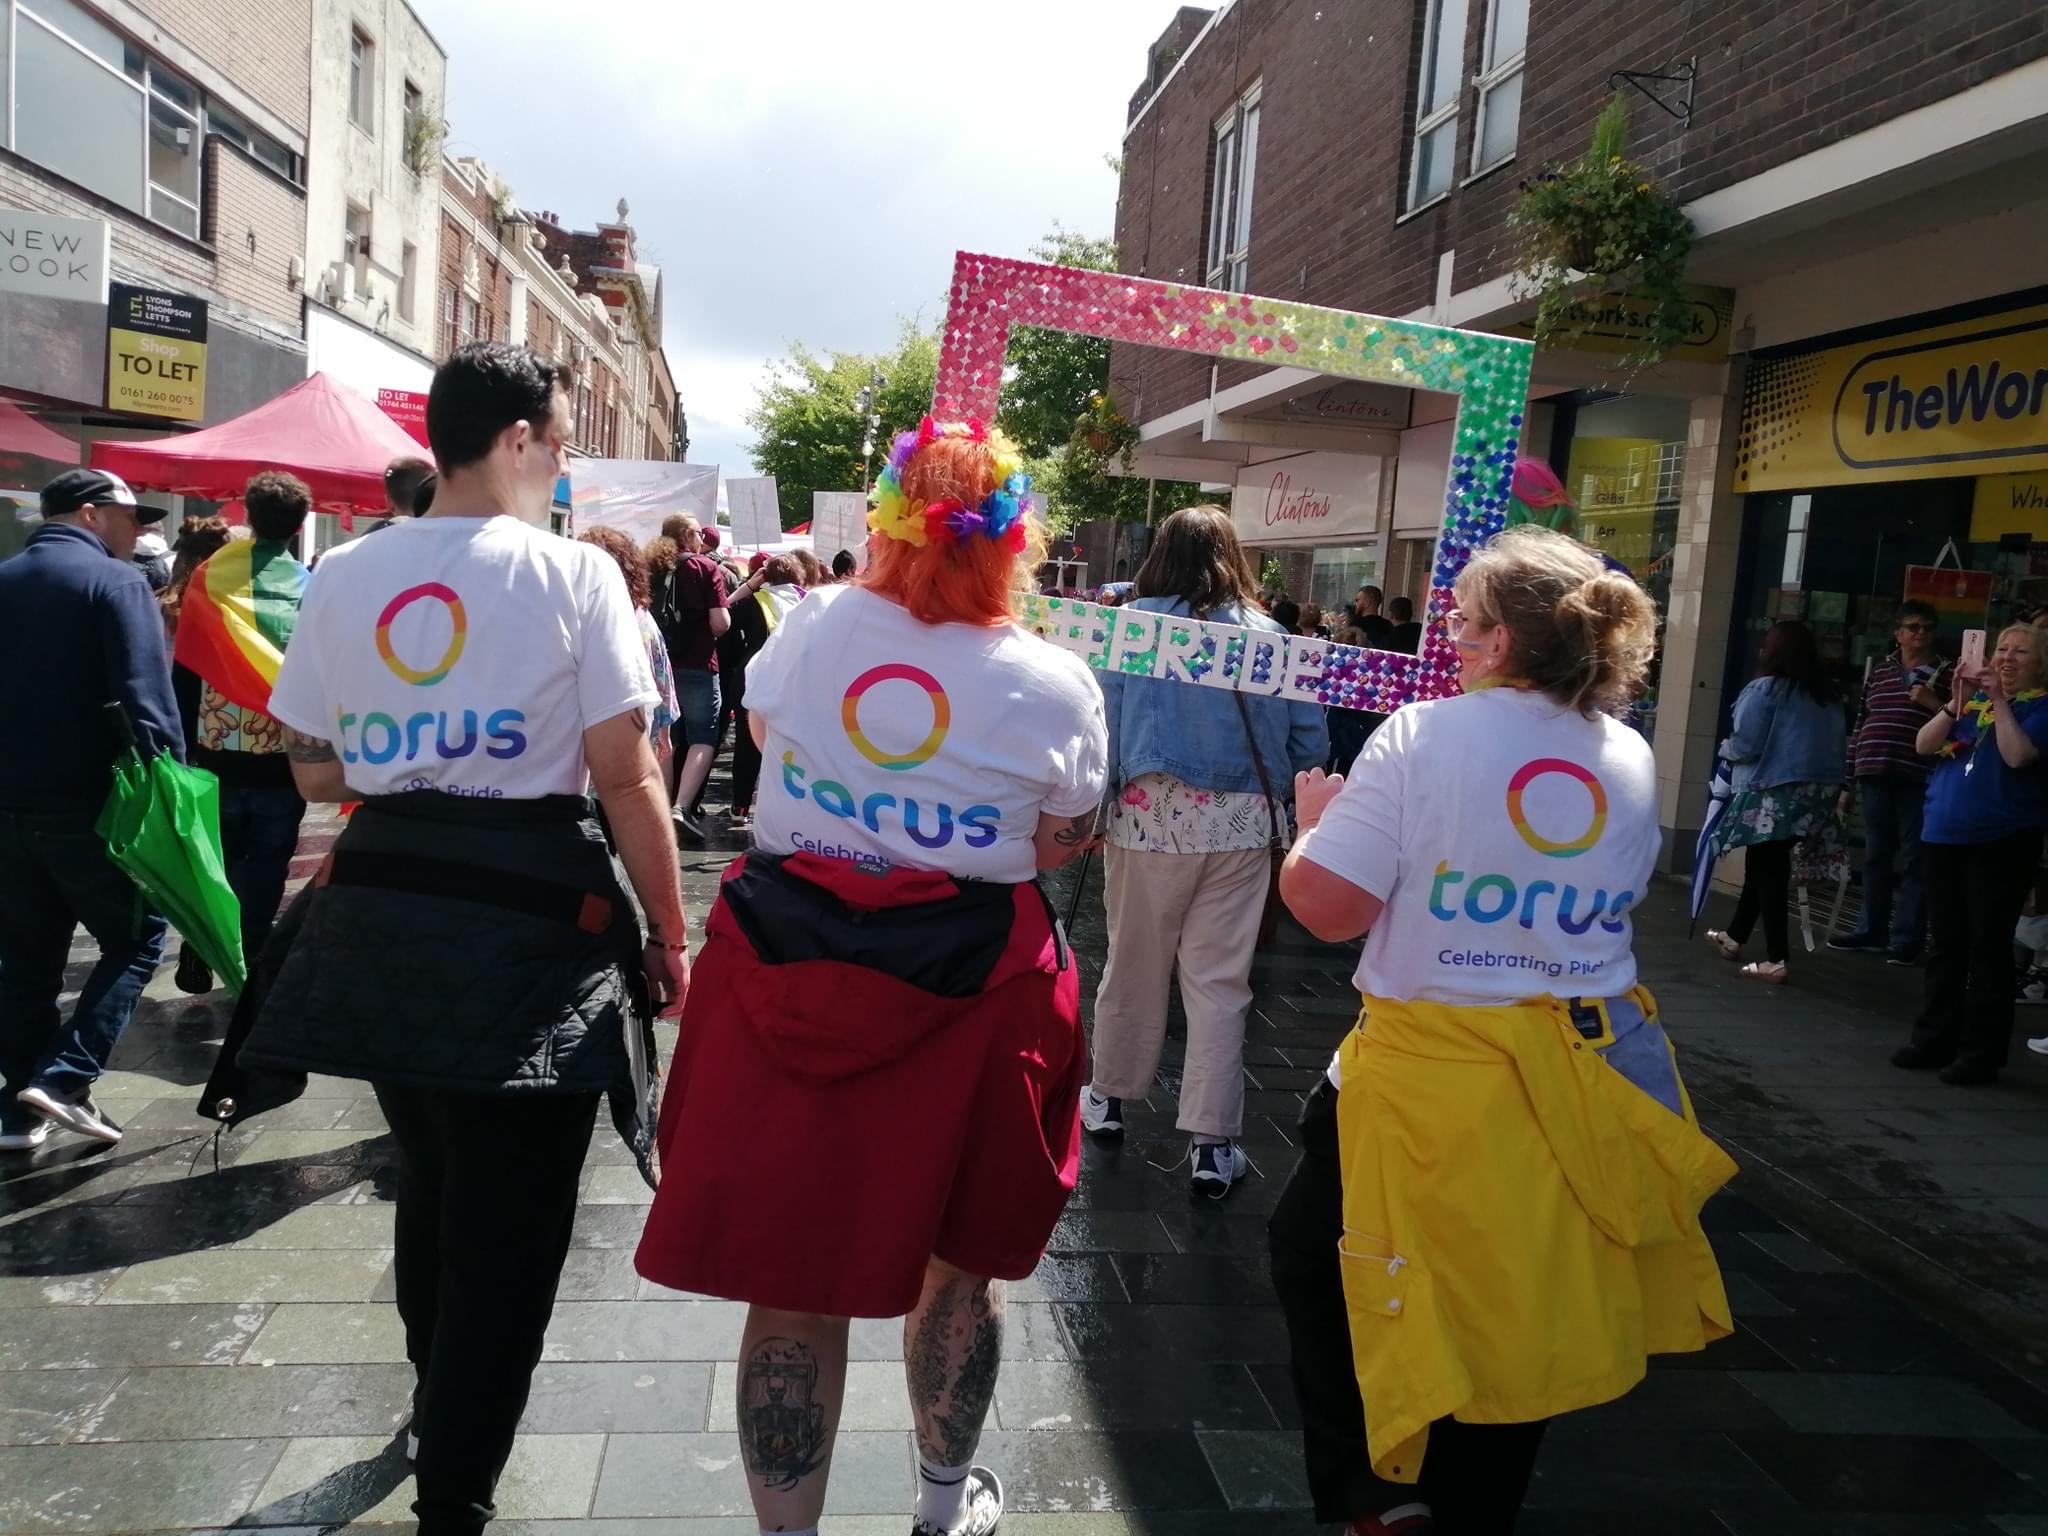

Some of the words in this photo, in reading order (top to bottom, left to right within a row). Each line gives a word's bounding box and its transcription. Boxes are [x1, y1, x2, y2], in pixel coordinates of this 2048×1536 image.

[0, 229, 81, 254] NEW
[0, 255, 88, 281] OOK
[145, 304, 192, 319] THOMPSON
[146, 295, 172, 307] LYONS
[145, 313, 170, 323] LETTS
[140, 338, 179, 359] Shop
[119, 353, 152, 375] TO
[159, 360, 199, 382] LET
[121, 387, 144, 398] 0161
[148, 391, 167, 401] 260
[169, 393, 194, 405] 0075
[379, 391, 392, 400] TO
[395, 392, 408, 401] LET
[1265, 472, 1330, 527] Clintons
[1047, 598, 1328, 702] #PRIDE
[337, 704, 527, 765] torus
[448, 784, 503, 799] Pride
[782, 751, 1000, 849] torus
[1429, 859, 1634, 935] torus
[1438, 950, 1562, 977] Celebrating
